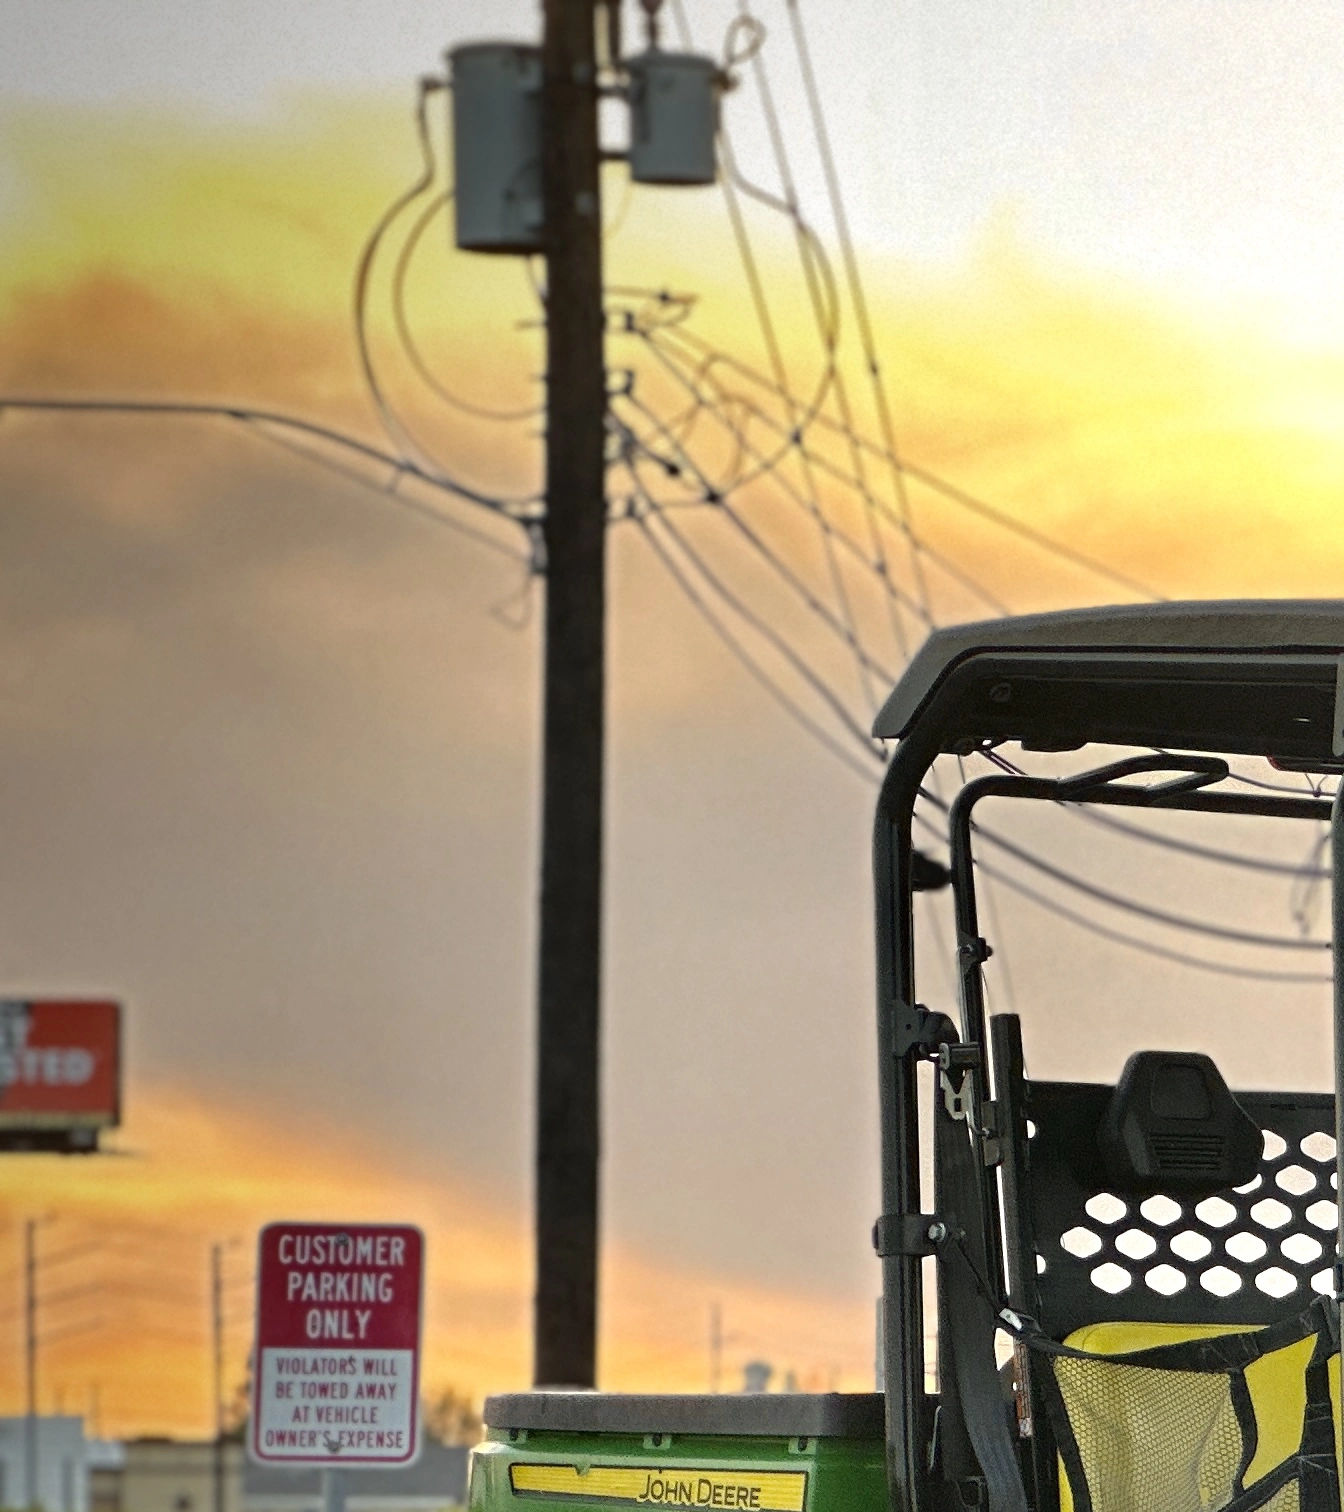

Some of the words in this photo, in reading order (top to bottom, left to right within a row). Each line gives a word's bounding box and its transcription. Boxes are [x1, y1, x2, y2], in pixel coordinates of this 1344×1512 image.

[278, 1234, 406, 1266] CUSTOMER
[287, 1271, 393, 1303] PARKING
[306, 1308, 372, 1339] ONLY
[275, 1357, 357, 1376] VIOLATORS
[363, 1358, 398, 1377] WILL
[275, 1381, 294, 1399] BE
[300, 1381, 349, 1400] TOWED
[355, 1382, 397, 1400] AWAY
[291, 1406, 311, 1423] AT
[316, 1406, 379, 1424] VEHICLE
[265, 1429, 331, 1448] OWNER'S
[338, 1430, 404, 1449] EXPENSE
[639, 1474, 693, 1502] JOHN
[697, 1478, 761, 1508] DEERE
